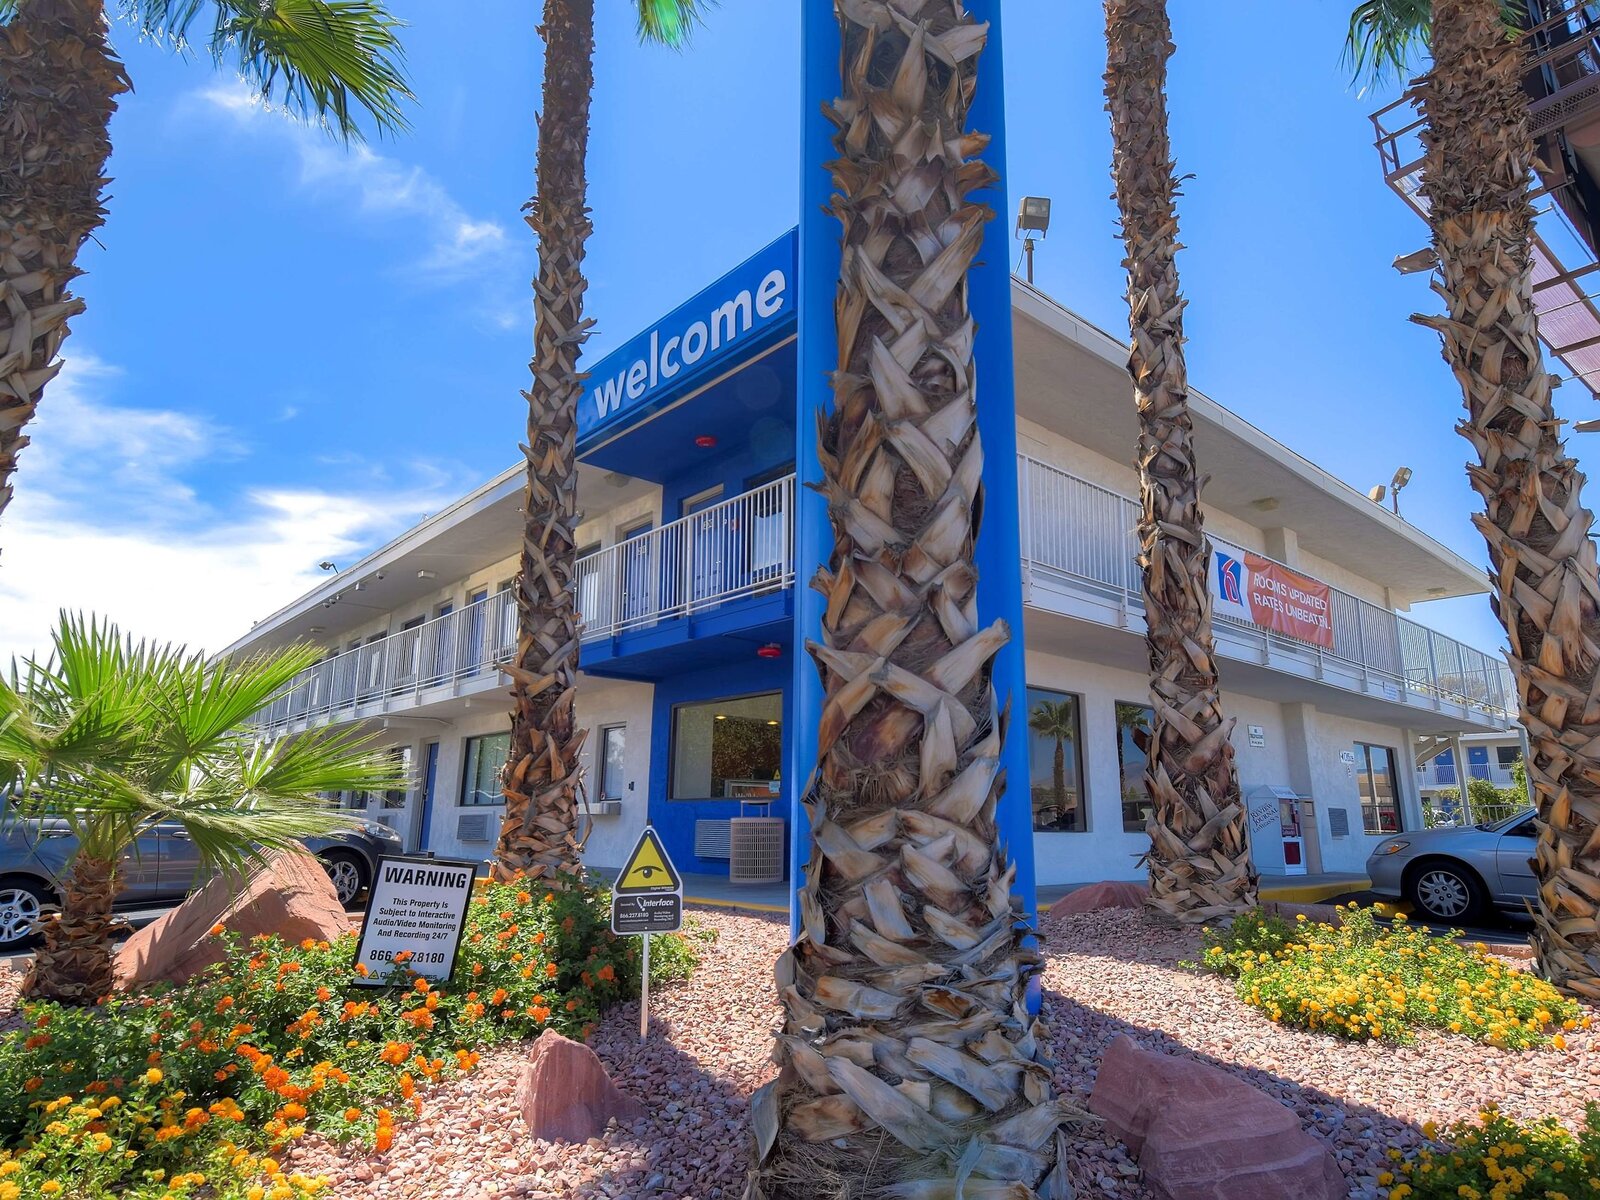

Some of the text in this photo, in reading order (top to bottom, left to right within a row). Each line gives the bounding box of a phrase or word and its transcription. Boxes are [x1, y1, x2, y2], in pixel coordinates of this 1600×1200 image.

[593, 269, 786, 418] welcome
[1253, 572, 1328, 611] ROOMS UPDATED
[1252, 592, 1284, 613] RATES
[1250, 802, 1273, 819] REVIEW
[1252, 807, 1279, 826] JOURNAL
[385, 867, 467, 889] WARNING
[393, 898, 448, 909] This Property Is
[643, 898, 674, 907] Interface
[379, 908, 407, 917] Subject
[418, 910, 456, 919] Interactive
[373, 918, 457, 931] Audio/Video Monitoring
[377, 929, 448, 941] And Recording 24/7
[370, 949, 445, 963] 866.7.8180
